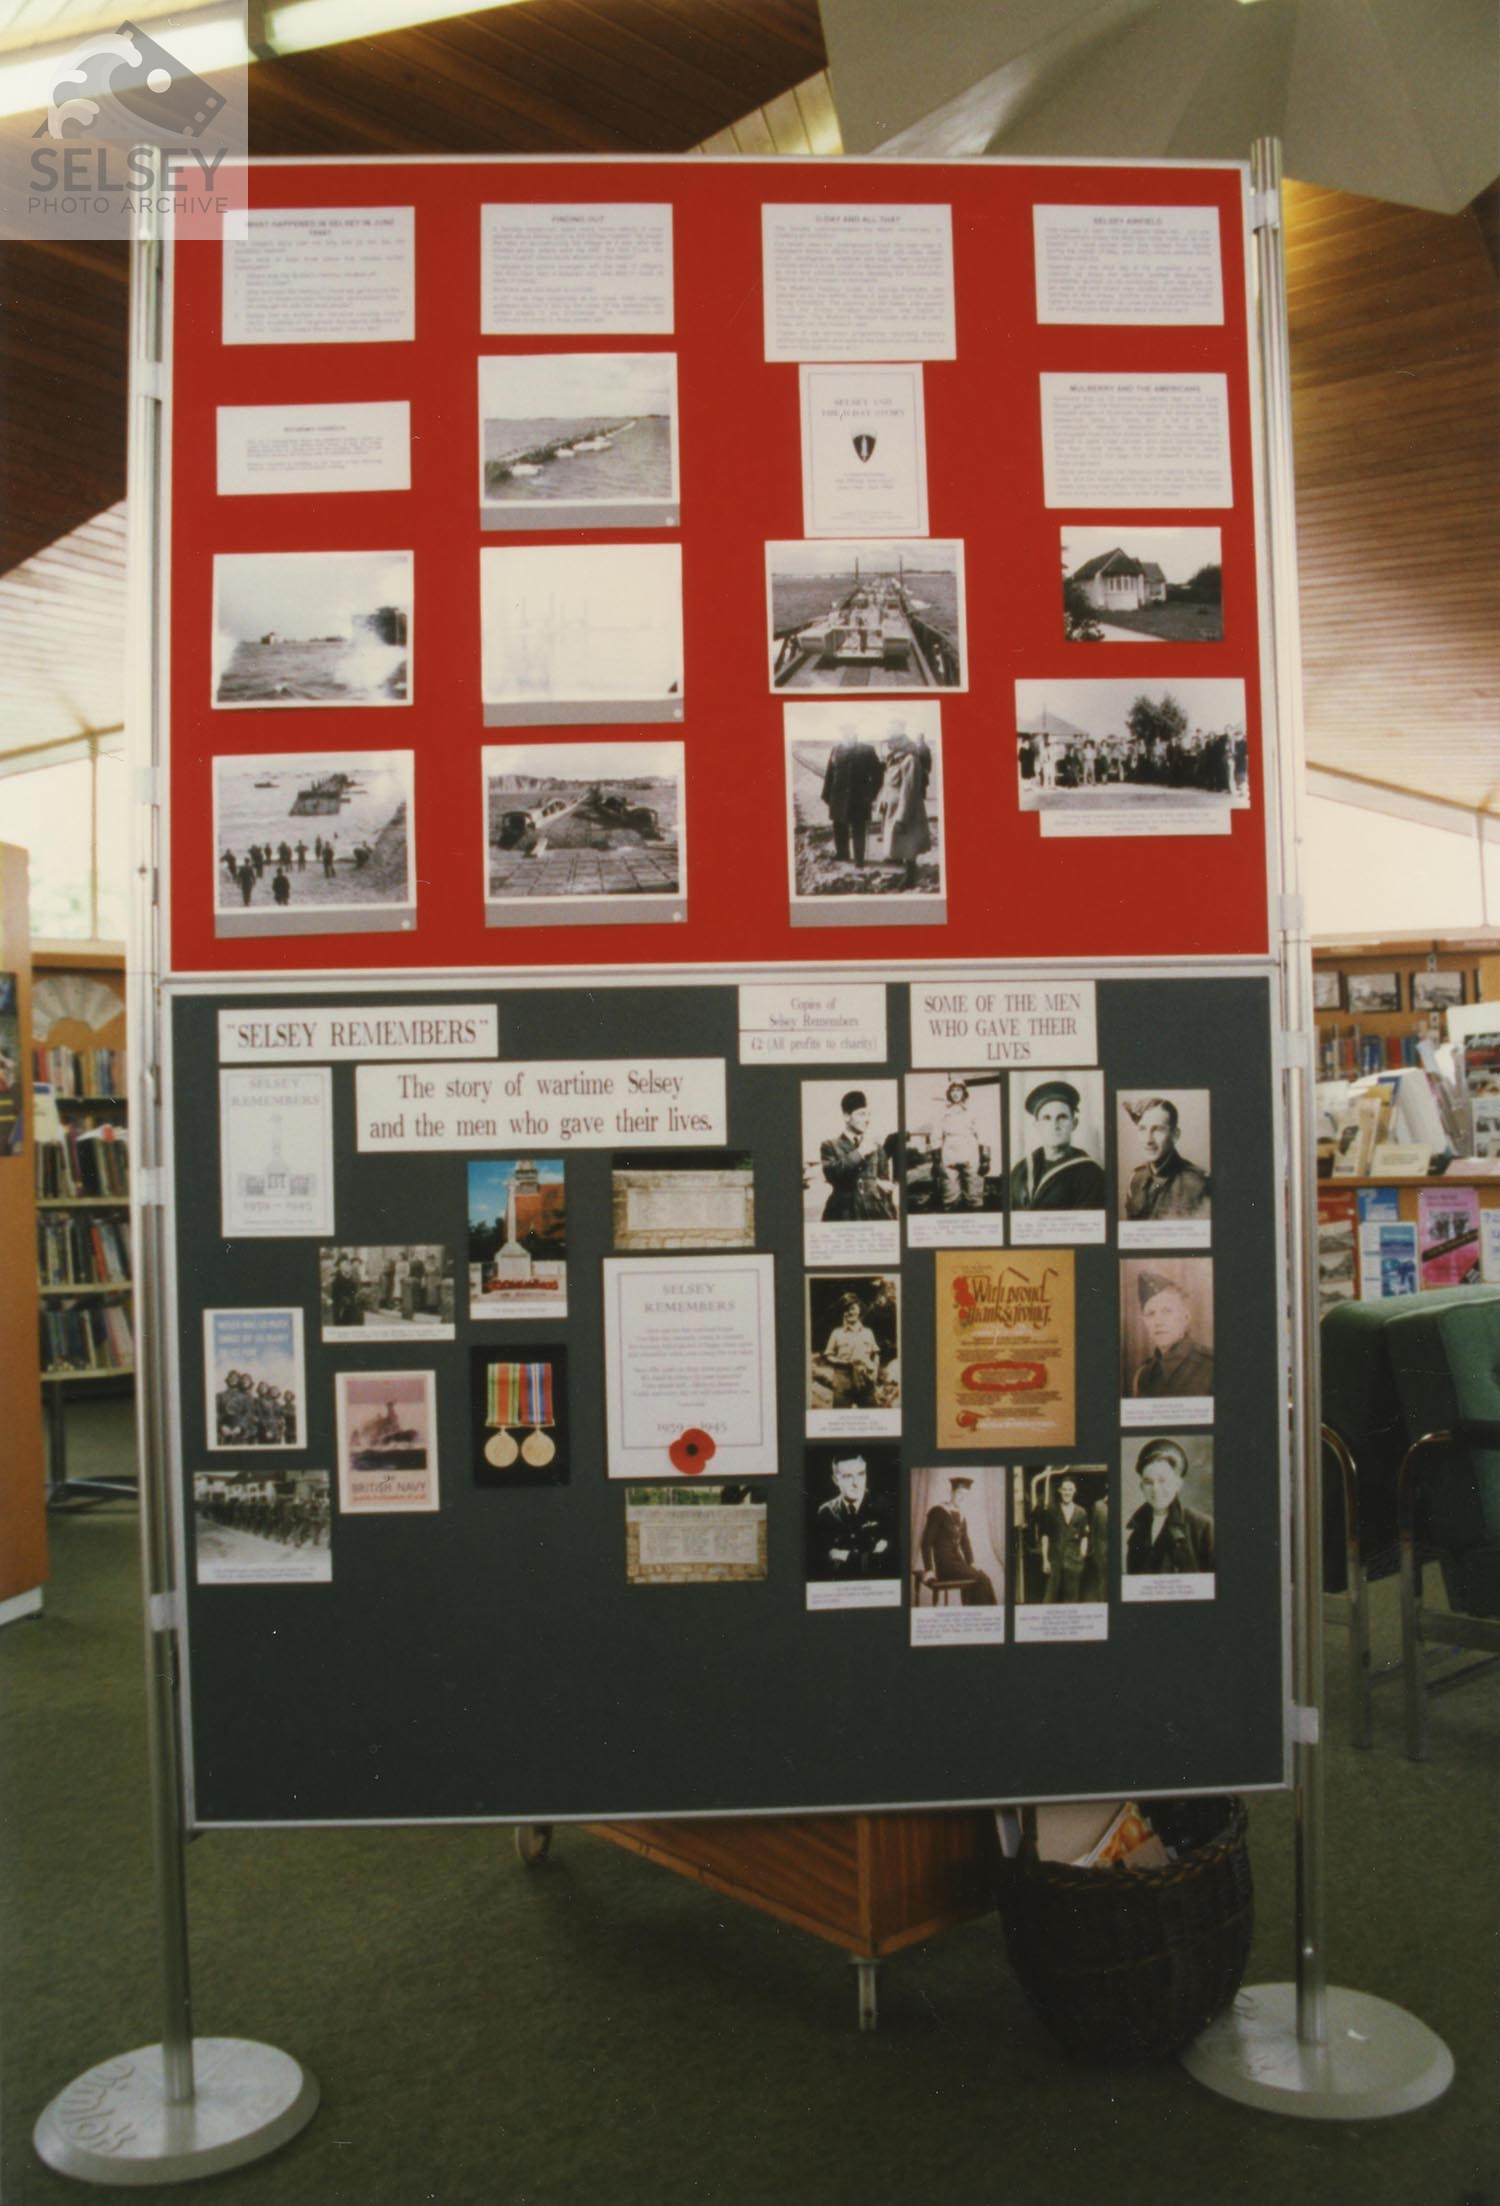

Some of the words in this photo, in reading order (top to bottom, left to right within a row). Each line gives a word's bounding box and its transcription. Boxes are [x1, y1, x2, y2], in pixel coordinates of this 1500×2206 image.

[790, 997, 822, 1013] Copies
[825, 996, 837, 1010] of
[923, 994, 969, 1014] SOME
[975, 993, 997, 1013] OF
[1003, 993, 1037, 1012] THE
[1044, 992, 1081, 1012] MEN
[803, 1013, 860, 1028] Remembers
[929, 1018, 969, 1037] WHO
[975, 1018, 1021, 1036] GAVE
[1027, 1016, 1078, 1036] THEIR
[790, 1036, 822, 1054] profits
[826, 1038, 837, 1050] to
[986, 1041, 1032, 1061] LIVES
[397, 1073, 435, 1099] The
[446, 1076, 493, 1103] story
[504, 1072, 524, 1097] of
[536, 1072, 615, 1096] wartime
[627, 1069, 683, 1100] Selsey
[369, 1113, 405, 1139] and
[414, 1113, 446, 1138] the
[456, 1117, 498, 1137] men
[510, 1110, 549, 1136] who
[559, 1115, 605, 1141] gave
[616, 1107, 660, 1133] their
[668, 1106, 713, 1133] lives.
[661, 1282, 716, 1296] SELSEY
[643, 1299, 736, 1314] REMEMBERS
